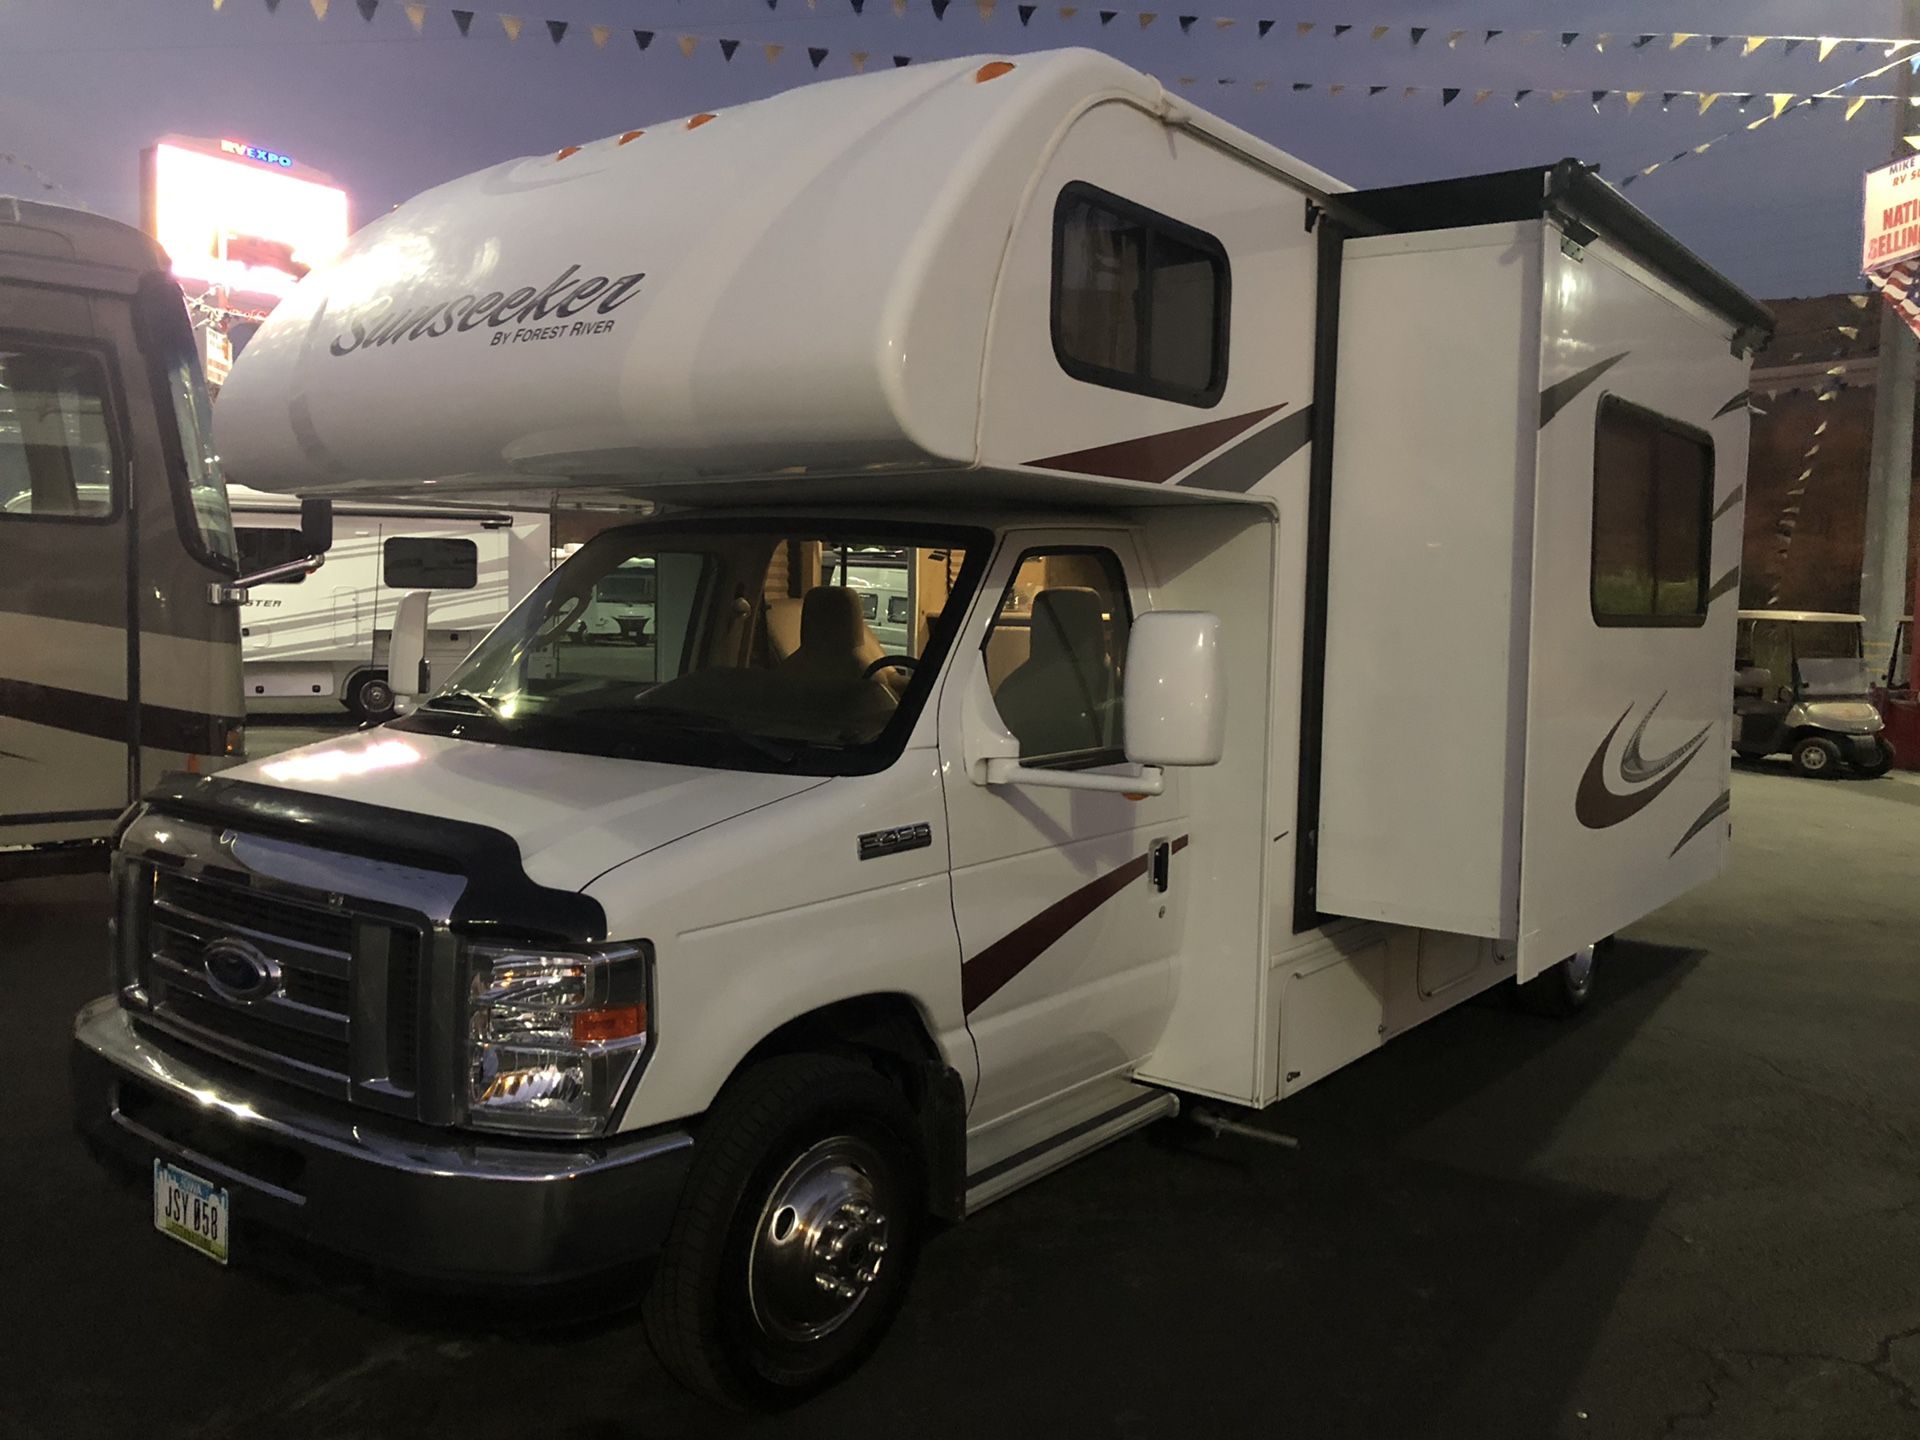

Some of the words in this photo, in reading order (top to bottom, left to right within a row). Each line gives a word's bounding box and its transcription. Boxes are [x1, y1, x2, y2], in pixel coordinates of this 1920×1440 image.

[246, 147, 293, 168] EXPO
[1889, 157, 1916, 176] MIKE
[1892, 173, 1907, 187] RV
[1882, 198, 1920, 231] NATI
[1867, 223, 1920, 260] SELLIN
[330, 264, 646, 357] Sunseeker
[512, 324, 569, 343] FOREST
[569, 320, 615, 337] RIVER
[165, 1186, 189, 1226] JSY
